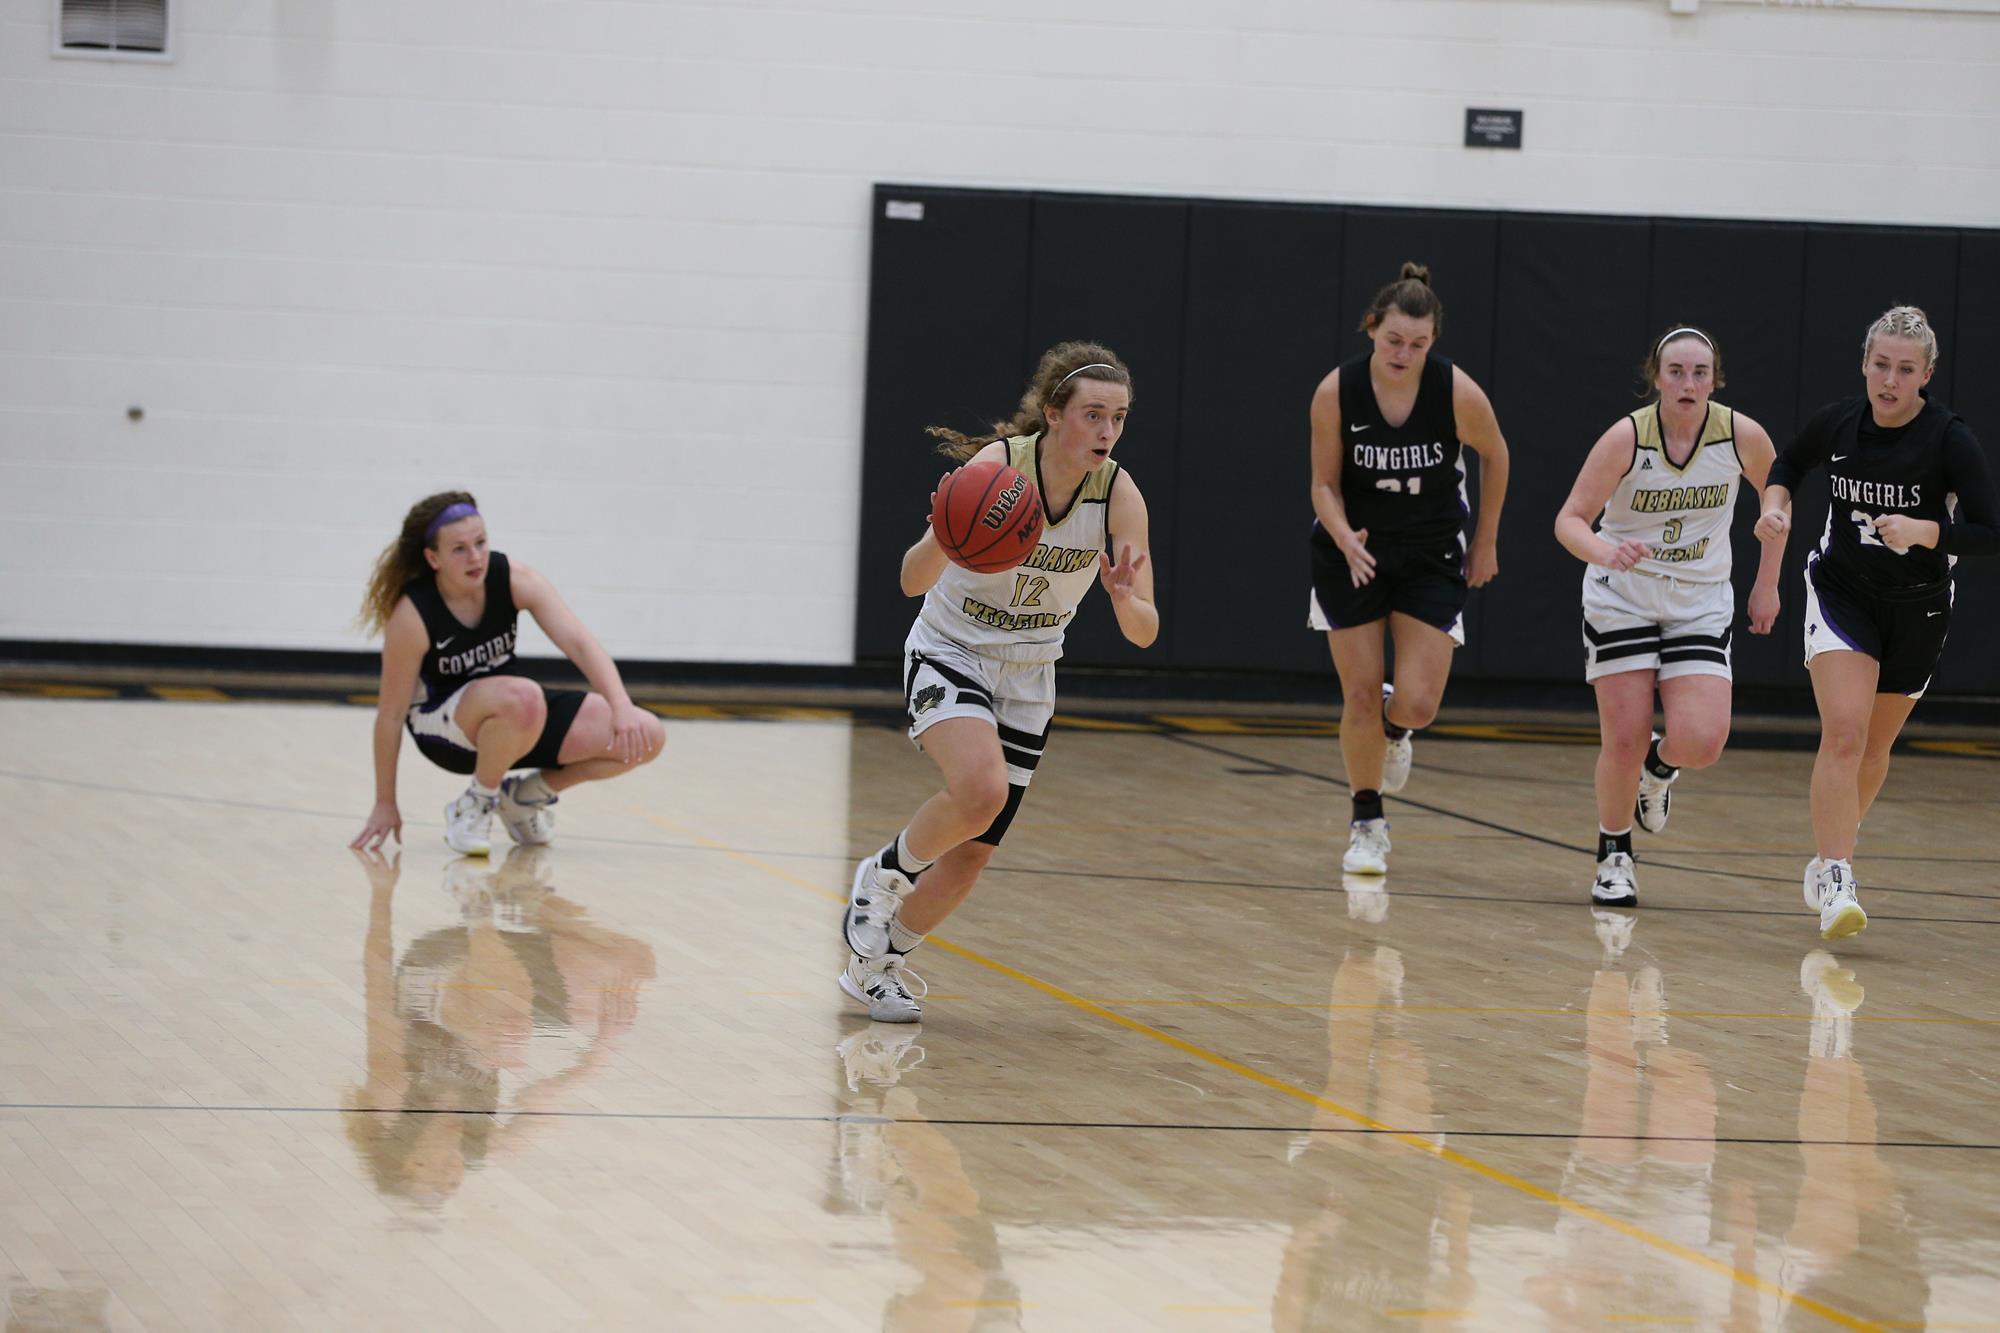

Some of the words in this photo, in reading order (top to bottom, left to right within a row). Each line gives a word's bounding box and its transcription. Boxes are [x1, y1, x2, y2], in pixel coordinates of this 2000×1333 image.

[1353, 441, 1444, 471] COWGIRLS
[979, 472, 1028, 532] Wilson
[1630, 483, 1729, 513] NEBRASKA
[1830, 474, 1921, 508] COWGIRLS
[1851, 509, 1886, 546] 2
[1018, 543, 1099, 573] RASKA
[1009, 572, 1050, 607] 12
